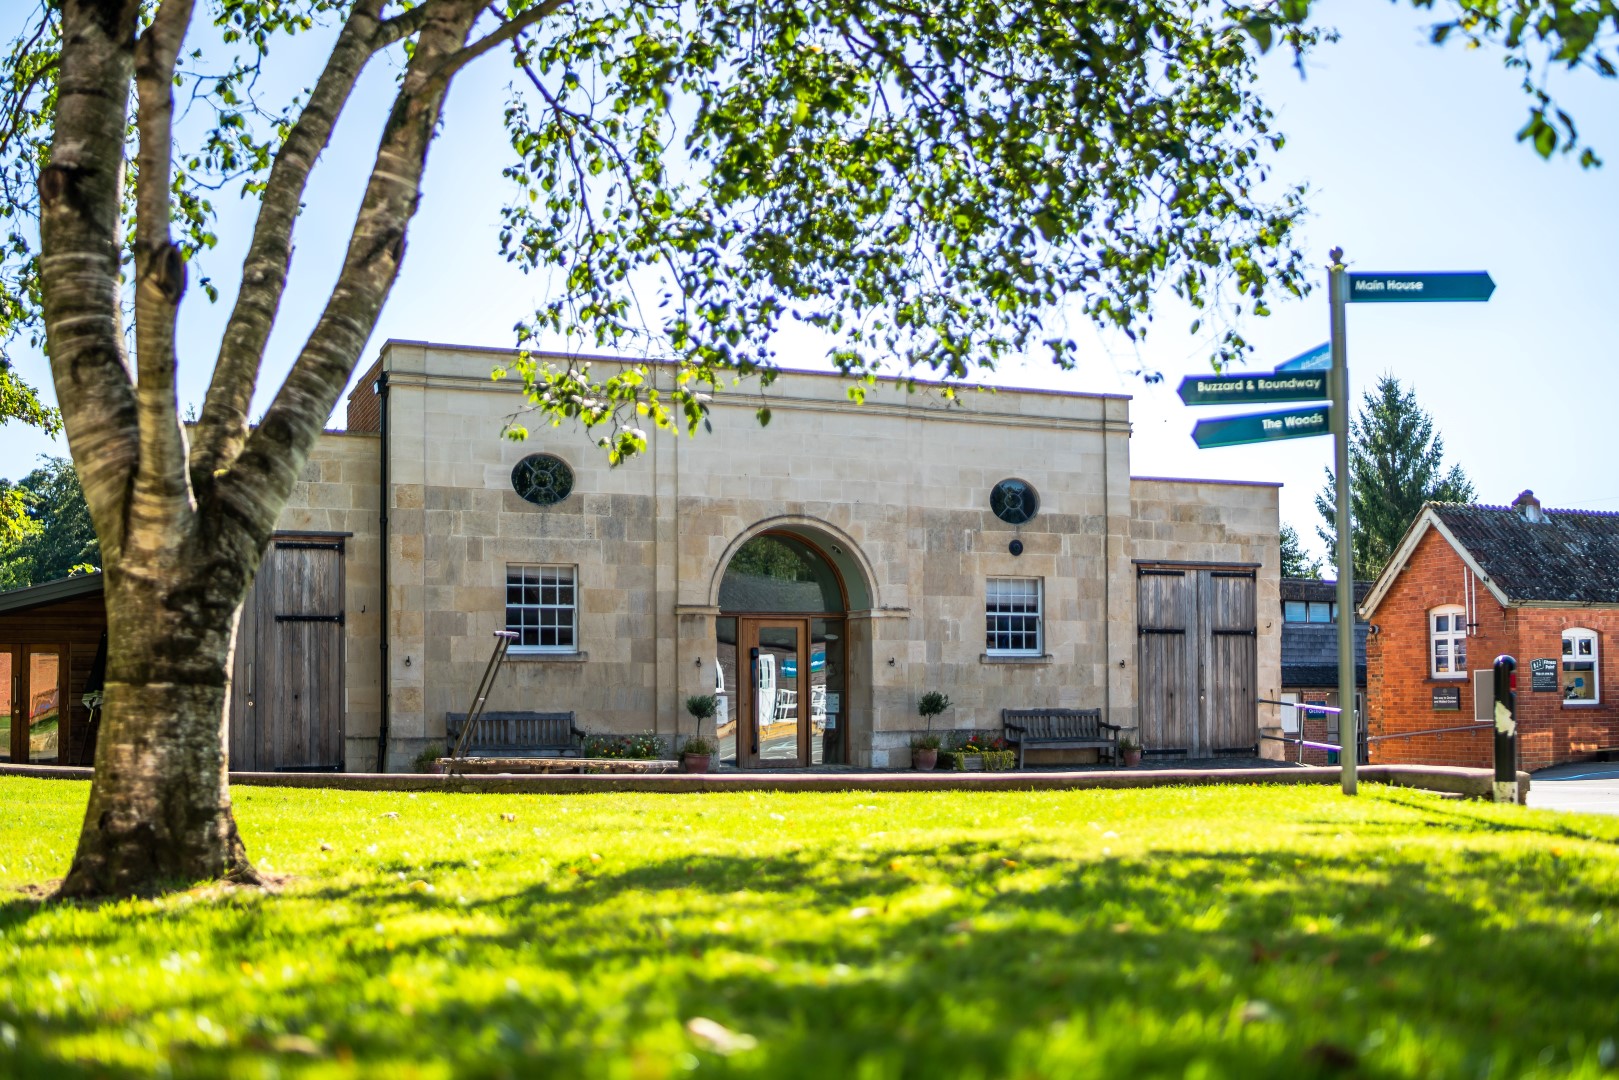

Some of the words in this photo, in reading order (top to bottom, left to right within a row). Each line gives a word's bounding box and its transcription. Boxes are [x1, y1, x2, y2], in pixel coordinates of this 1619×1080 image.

[1355, 279, 1385, 290] Main
[1386, 279, 1424, 290] House
[1197, 380, 1244, 392] Buzzard
[1246, 380, 1255, 390] &
[1257, 378, 1321, 389] Roundway
[1262, 418, 1282, 430] The
[1284, 413, 1323, 427] Woods
